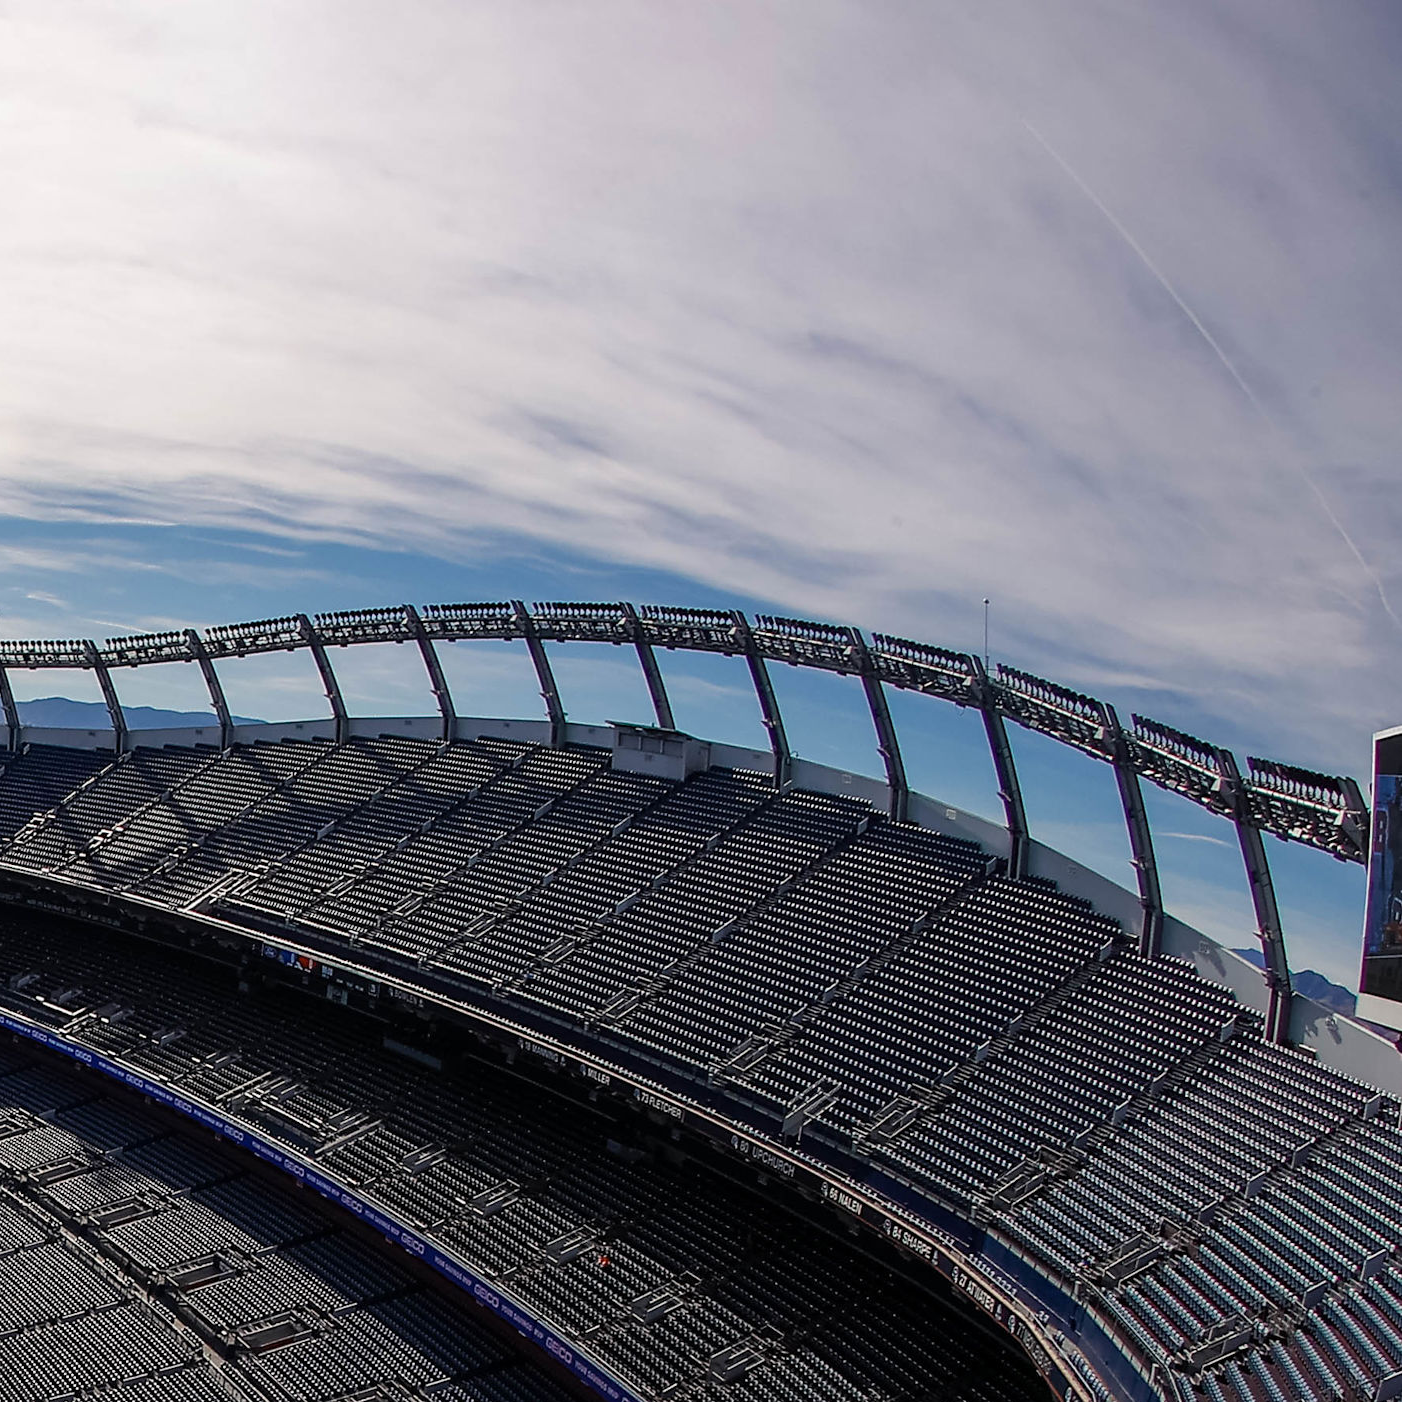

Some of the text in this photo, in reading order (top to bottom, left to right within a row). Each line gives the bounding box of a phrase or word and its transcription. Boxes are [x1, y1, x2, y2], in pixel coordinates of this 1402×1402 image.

[74, 1049, 92, 1063] GEICO
[125, 1073, 144, 1089] GEICO
[587, 1066, 611, 1086] MILLER
[173, 1097, 193, 1114] GEICO
[641, 1091, 682, 1119] 73 FLETCHER
[223, 1124, 244, 1142] GEICO
[283, 1158, 306, 1178] GEICO
[752, 1148, 795, 1178] UPCHURCH
[340, 1193, 363, 1214] GEICO
[828, 1187, 863, 1216] 66 NALEN
[400, 1232, 425, 1255] GEICO
[891, 1225, 933, 1260] 84 SHARPE
[474, 1284, 500, 1309] GEICO
[965, 1279, 995, 1312] ATWATER
[546, 1336, 573, 1365] GEICO
